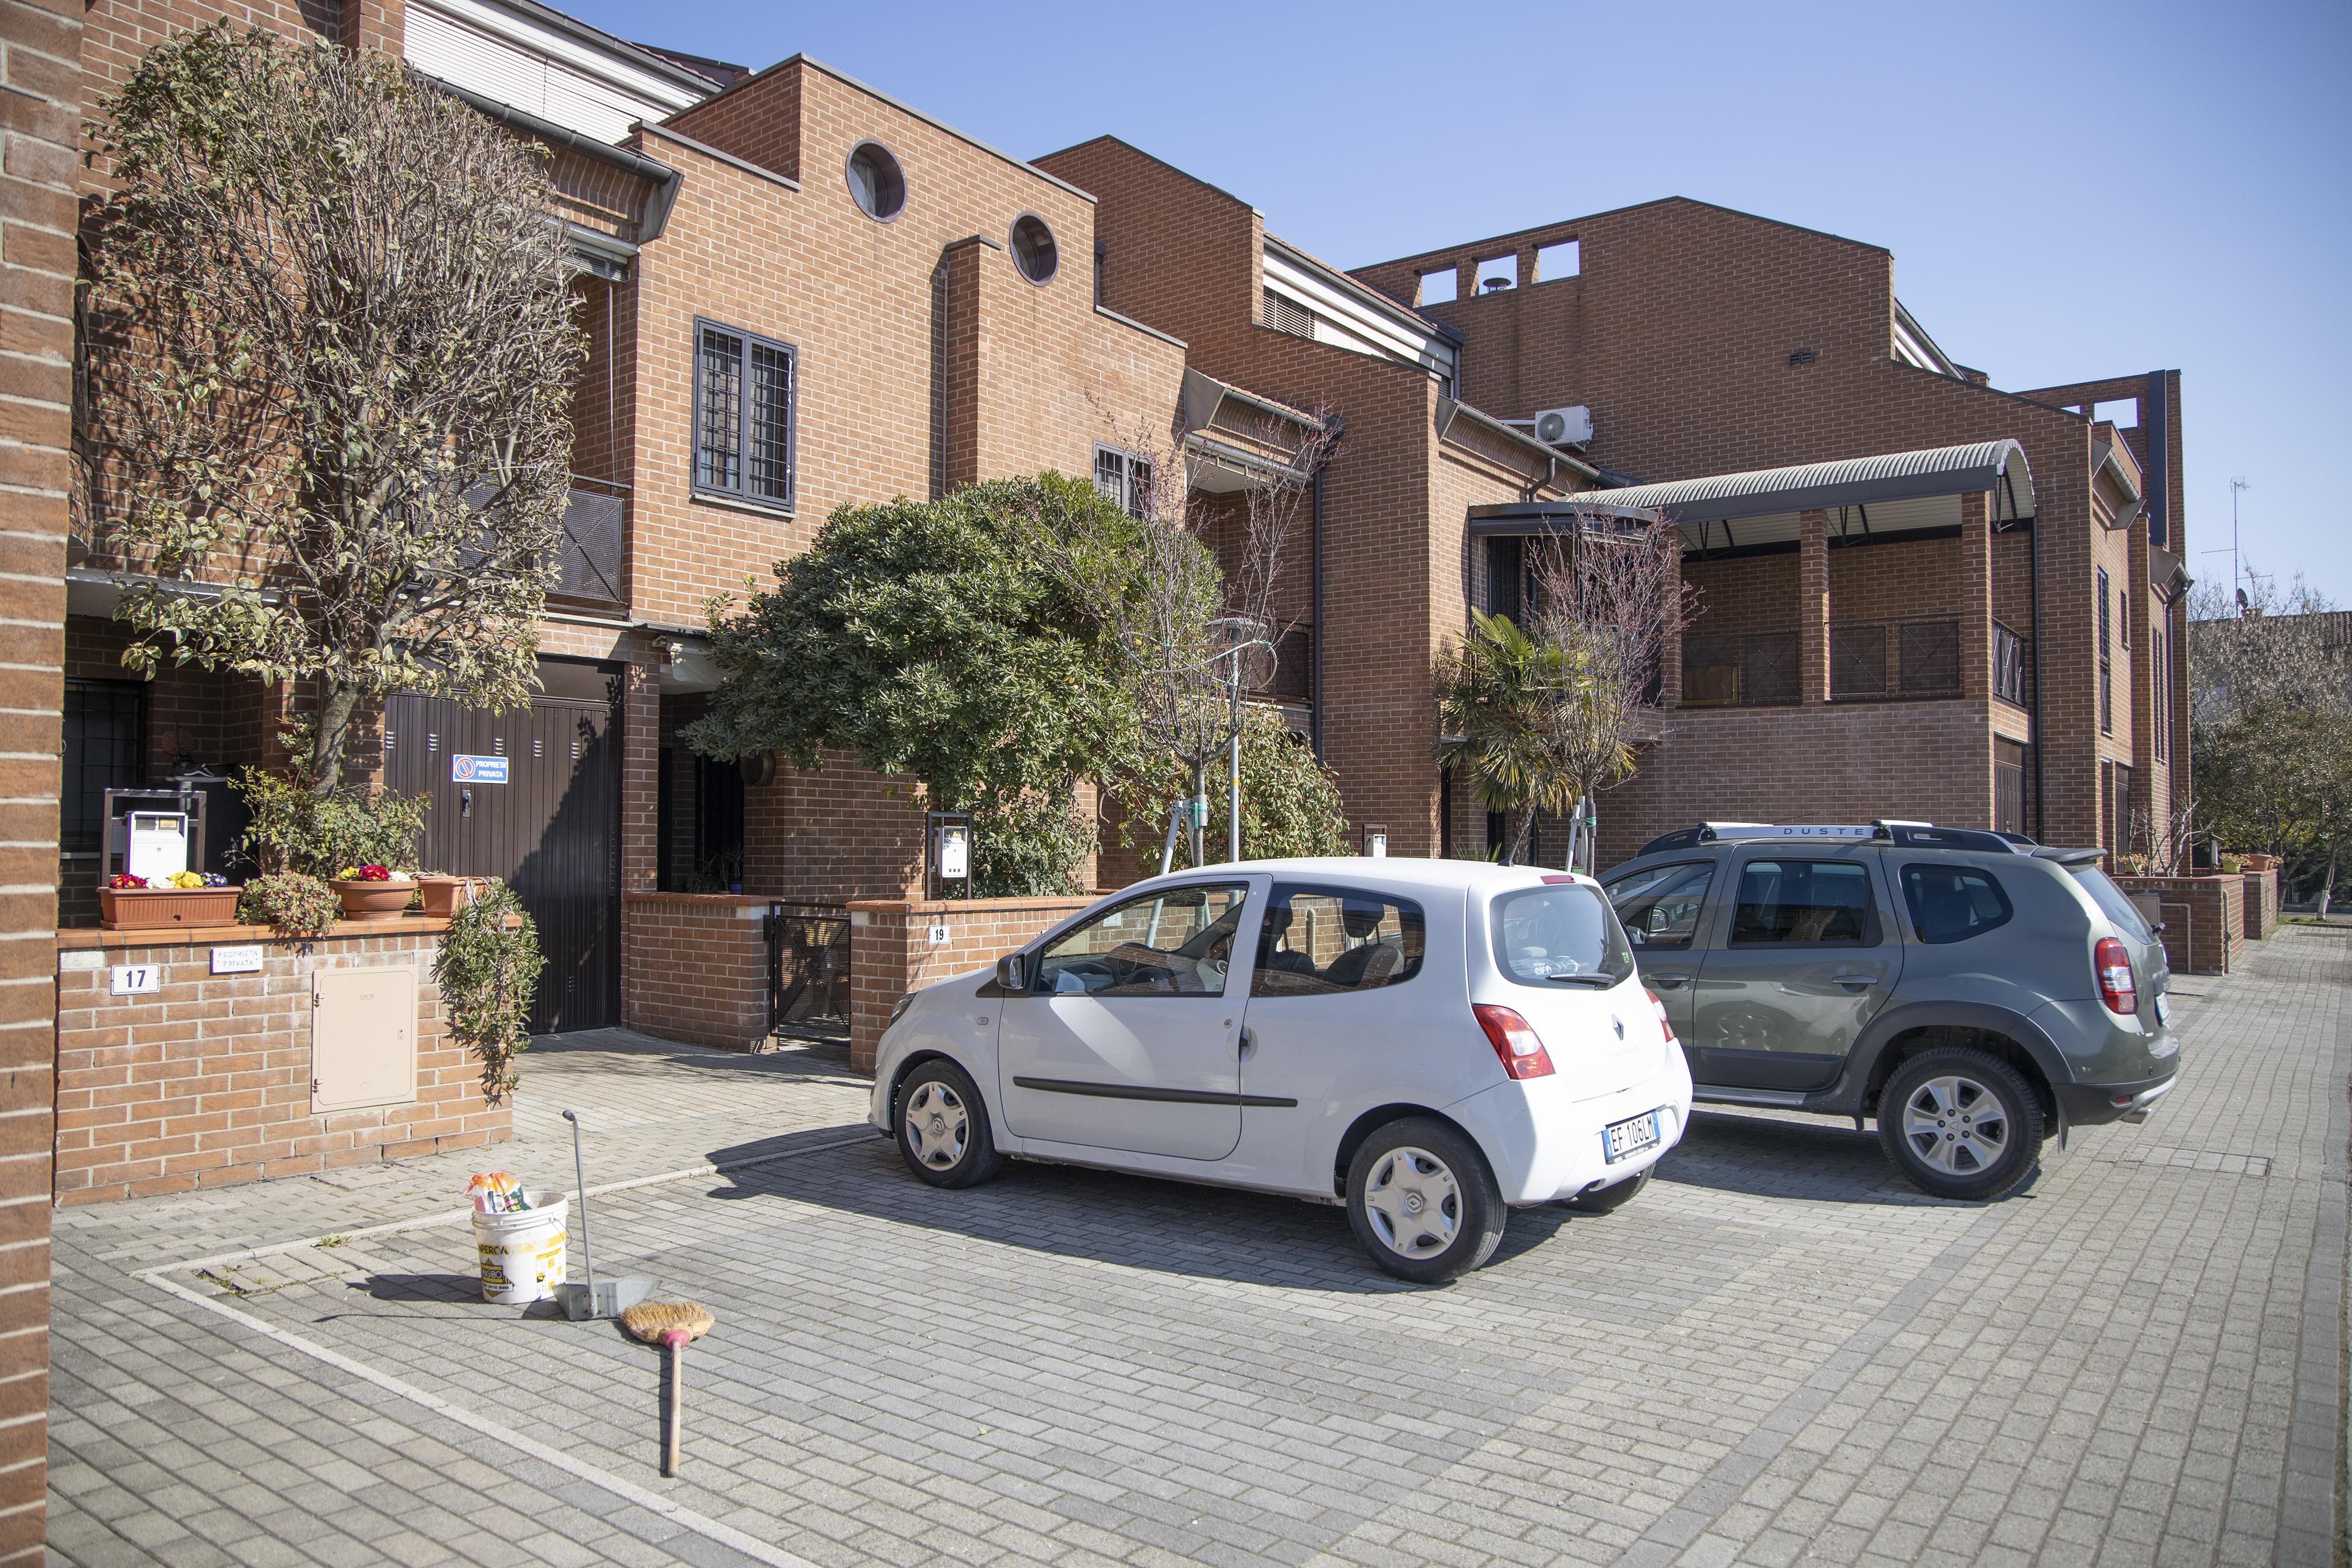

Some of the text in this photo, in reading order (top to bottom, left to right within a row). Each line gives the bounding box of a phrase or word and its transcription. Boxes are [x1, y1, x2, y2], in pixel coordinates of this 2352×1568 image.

[478, 770, 503, 778] PRIVATA
[935, 929, 944, 940] 19
[223, 960, 254, 968] PRIVATA
[126, 970, 146, 988] 17
[1608, 1045, 1639, 1059] TWINGO
[1611, 1115, 1654, 1153] EF 106LM
